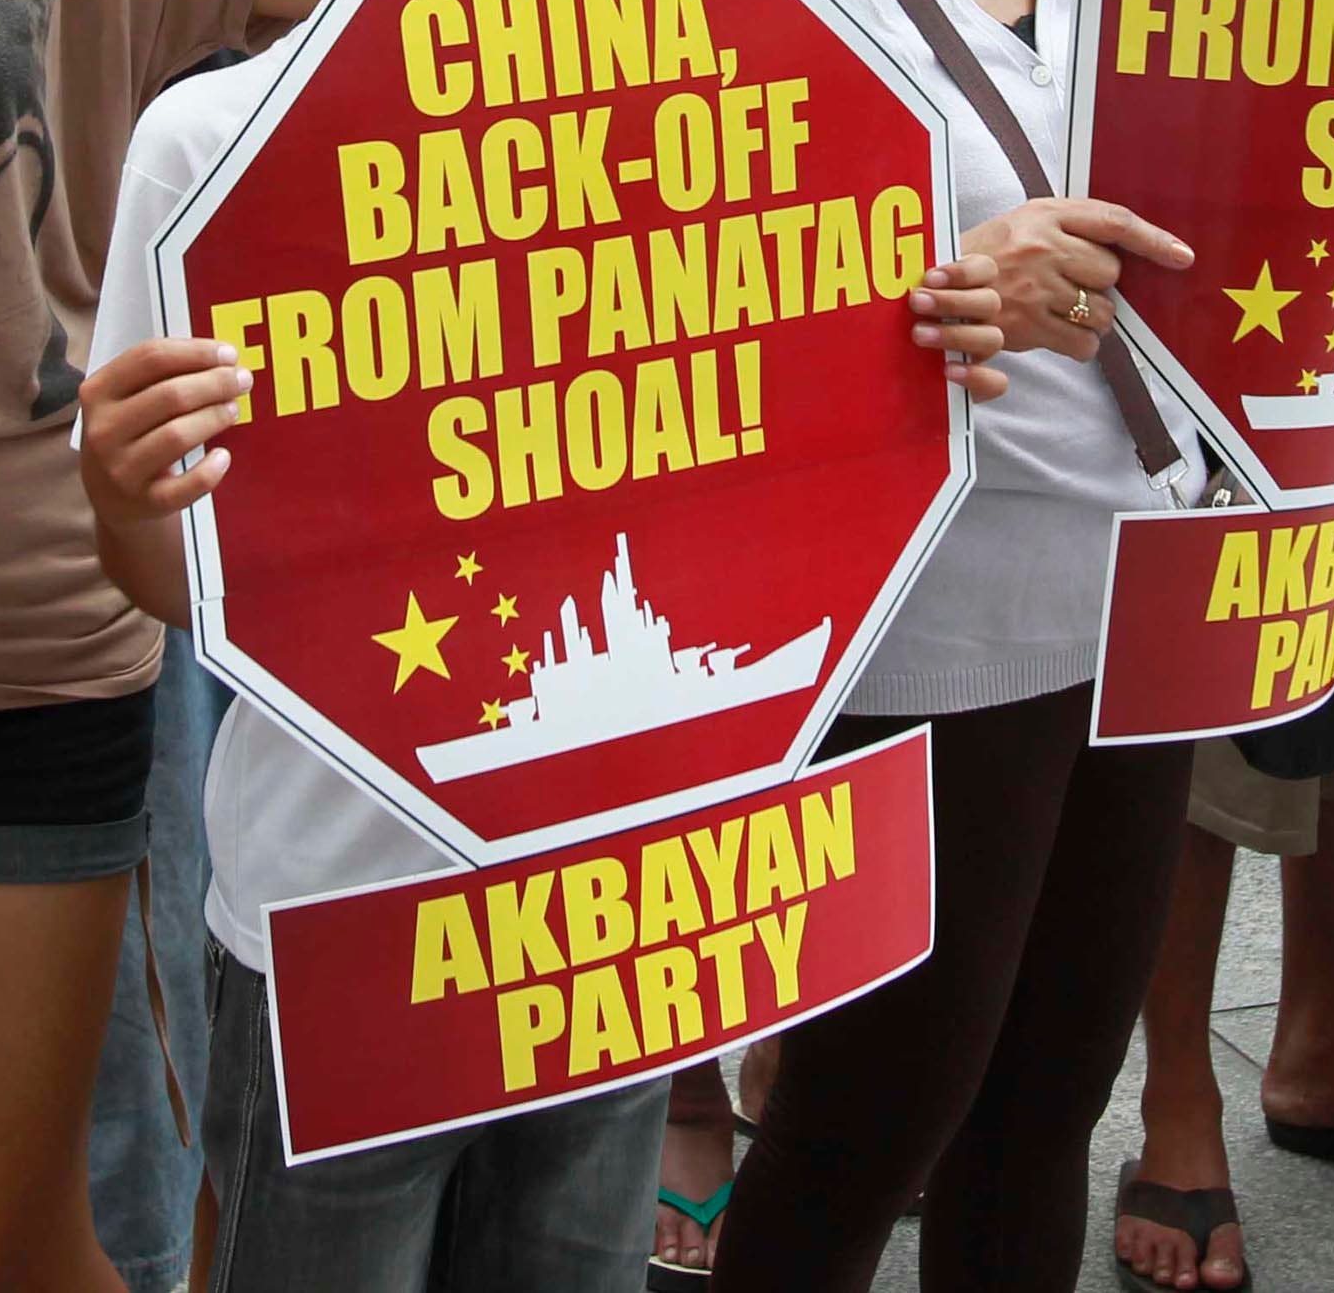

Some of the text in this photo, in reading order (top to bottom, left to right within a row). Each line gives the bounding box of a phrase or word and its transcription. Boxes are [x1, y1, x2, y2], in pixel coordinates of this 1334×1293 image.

[337, 77, 810, 266] BACK-OFF
[211, 184, 925, 426] FROM PANATAG
[427, 340, 766, 521] SHOAL!
[410, 781, 856, 1005] AKBAYAN
[496, 901, 808, 1093] PARTY
